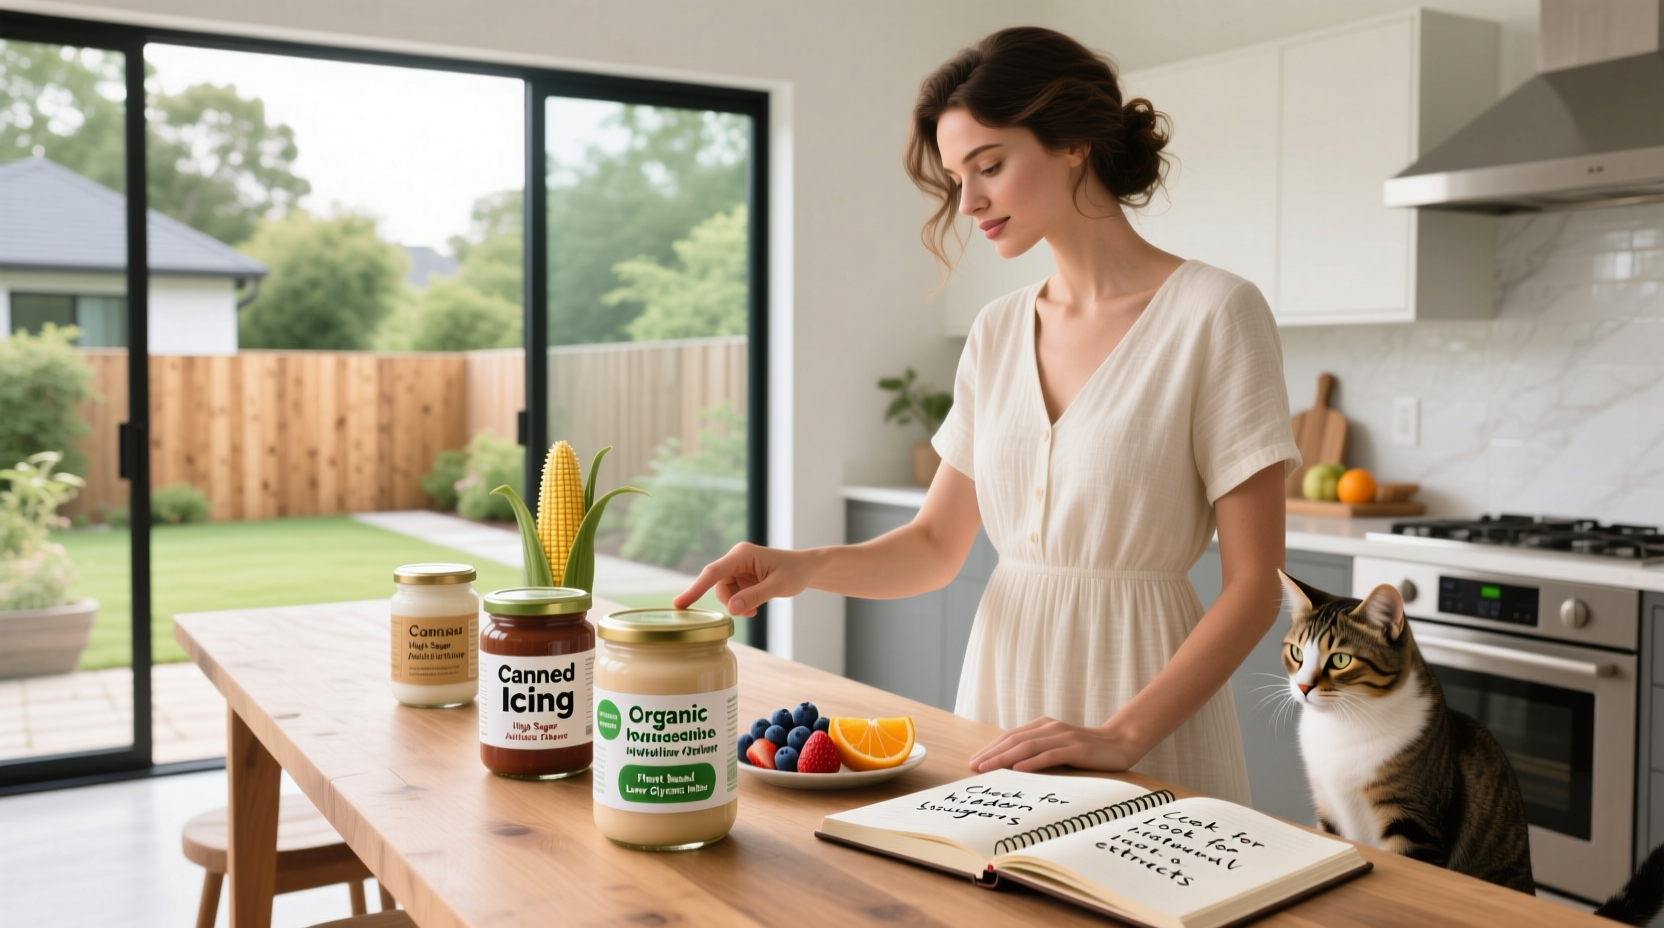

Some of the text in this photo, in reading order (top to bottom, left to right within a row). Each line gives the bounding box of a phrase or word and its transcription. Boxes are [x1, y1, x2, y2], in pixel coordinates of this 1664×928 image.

[498, 662, 575, 684] Canned
[502, 686, 574, 719] Icing
[629, 703, 708, 731] Organic
[1038, 793, 1070, 804] for
[1142, 817, 1195, 839] Look
[1205, 838, 1239, 854] for
[1231, 830, 1266, 849] for
